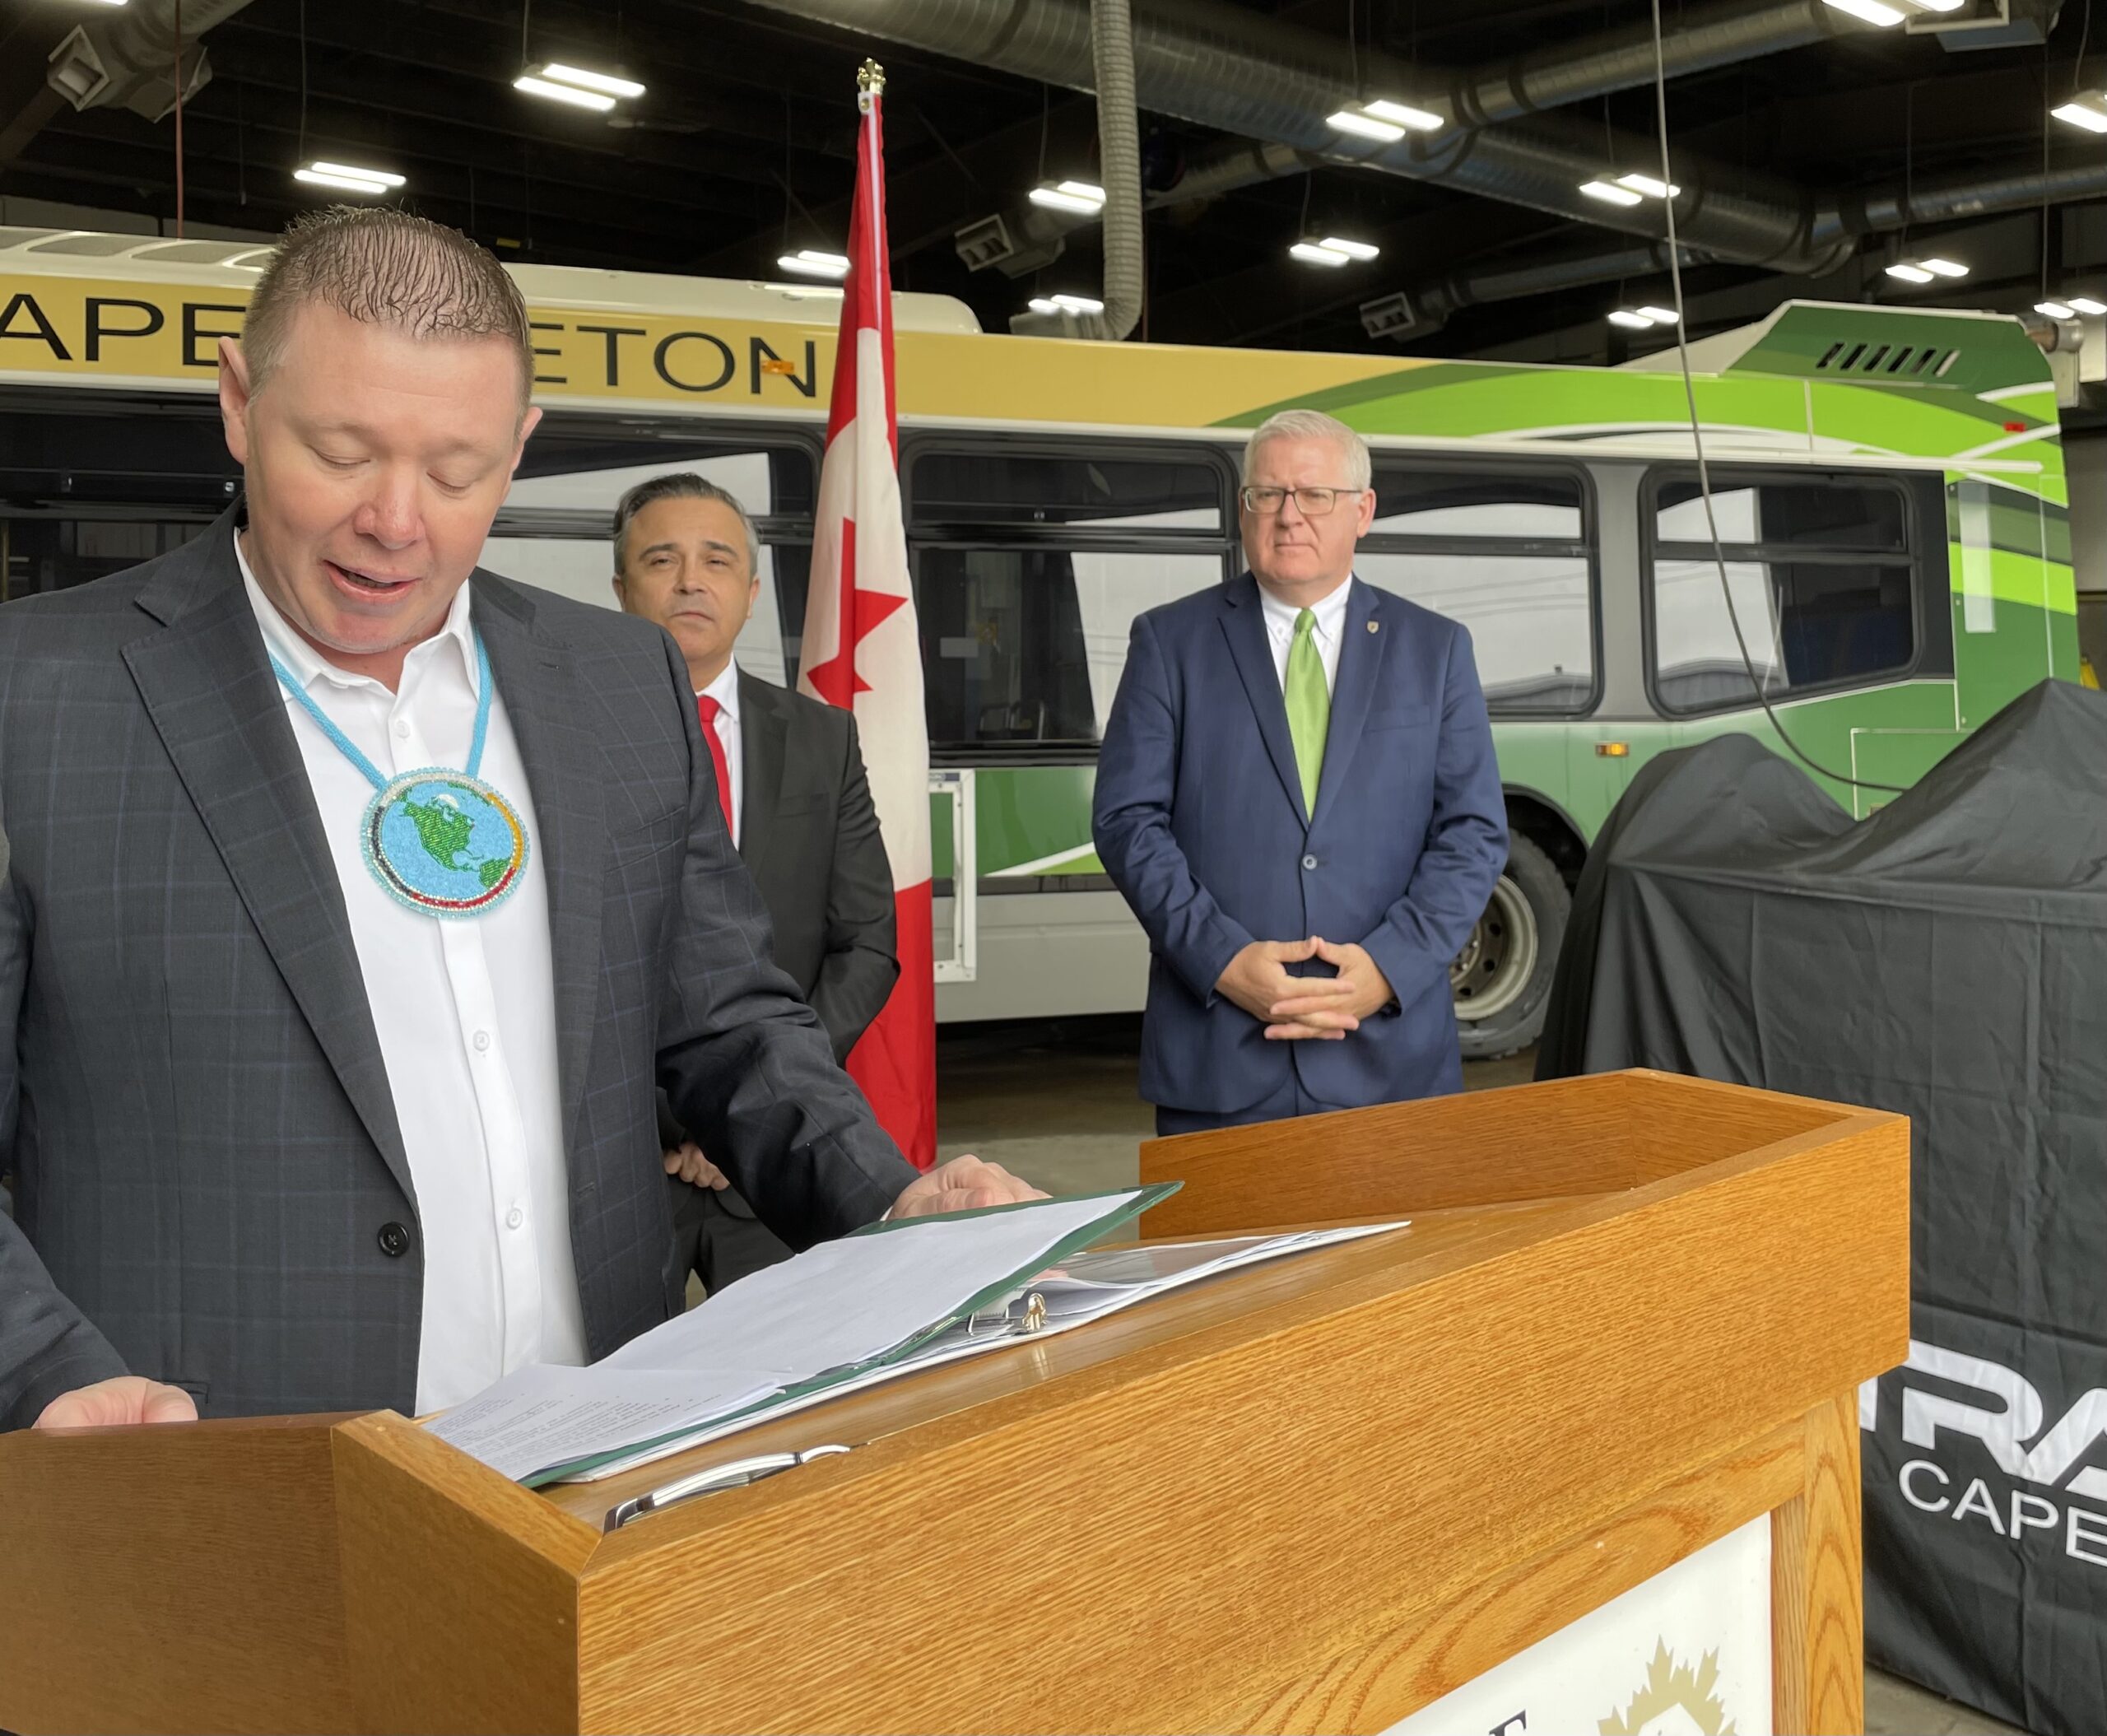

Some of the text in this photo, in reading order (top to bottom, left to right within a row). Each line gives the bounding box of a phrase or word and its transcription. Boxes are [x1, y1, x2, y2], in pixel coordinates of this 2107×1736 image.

[0, 293, 246, 367] APE
[1858, 1339, 2107, 1501] RA
[1899, 1459, 2107, 1567] CAPE
